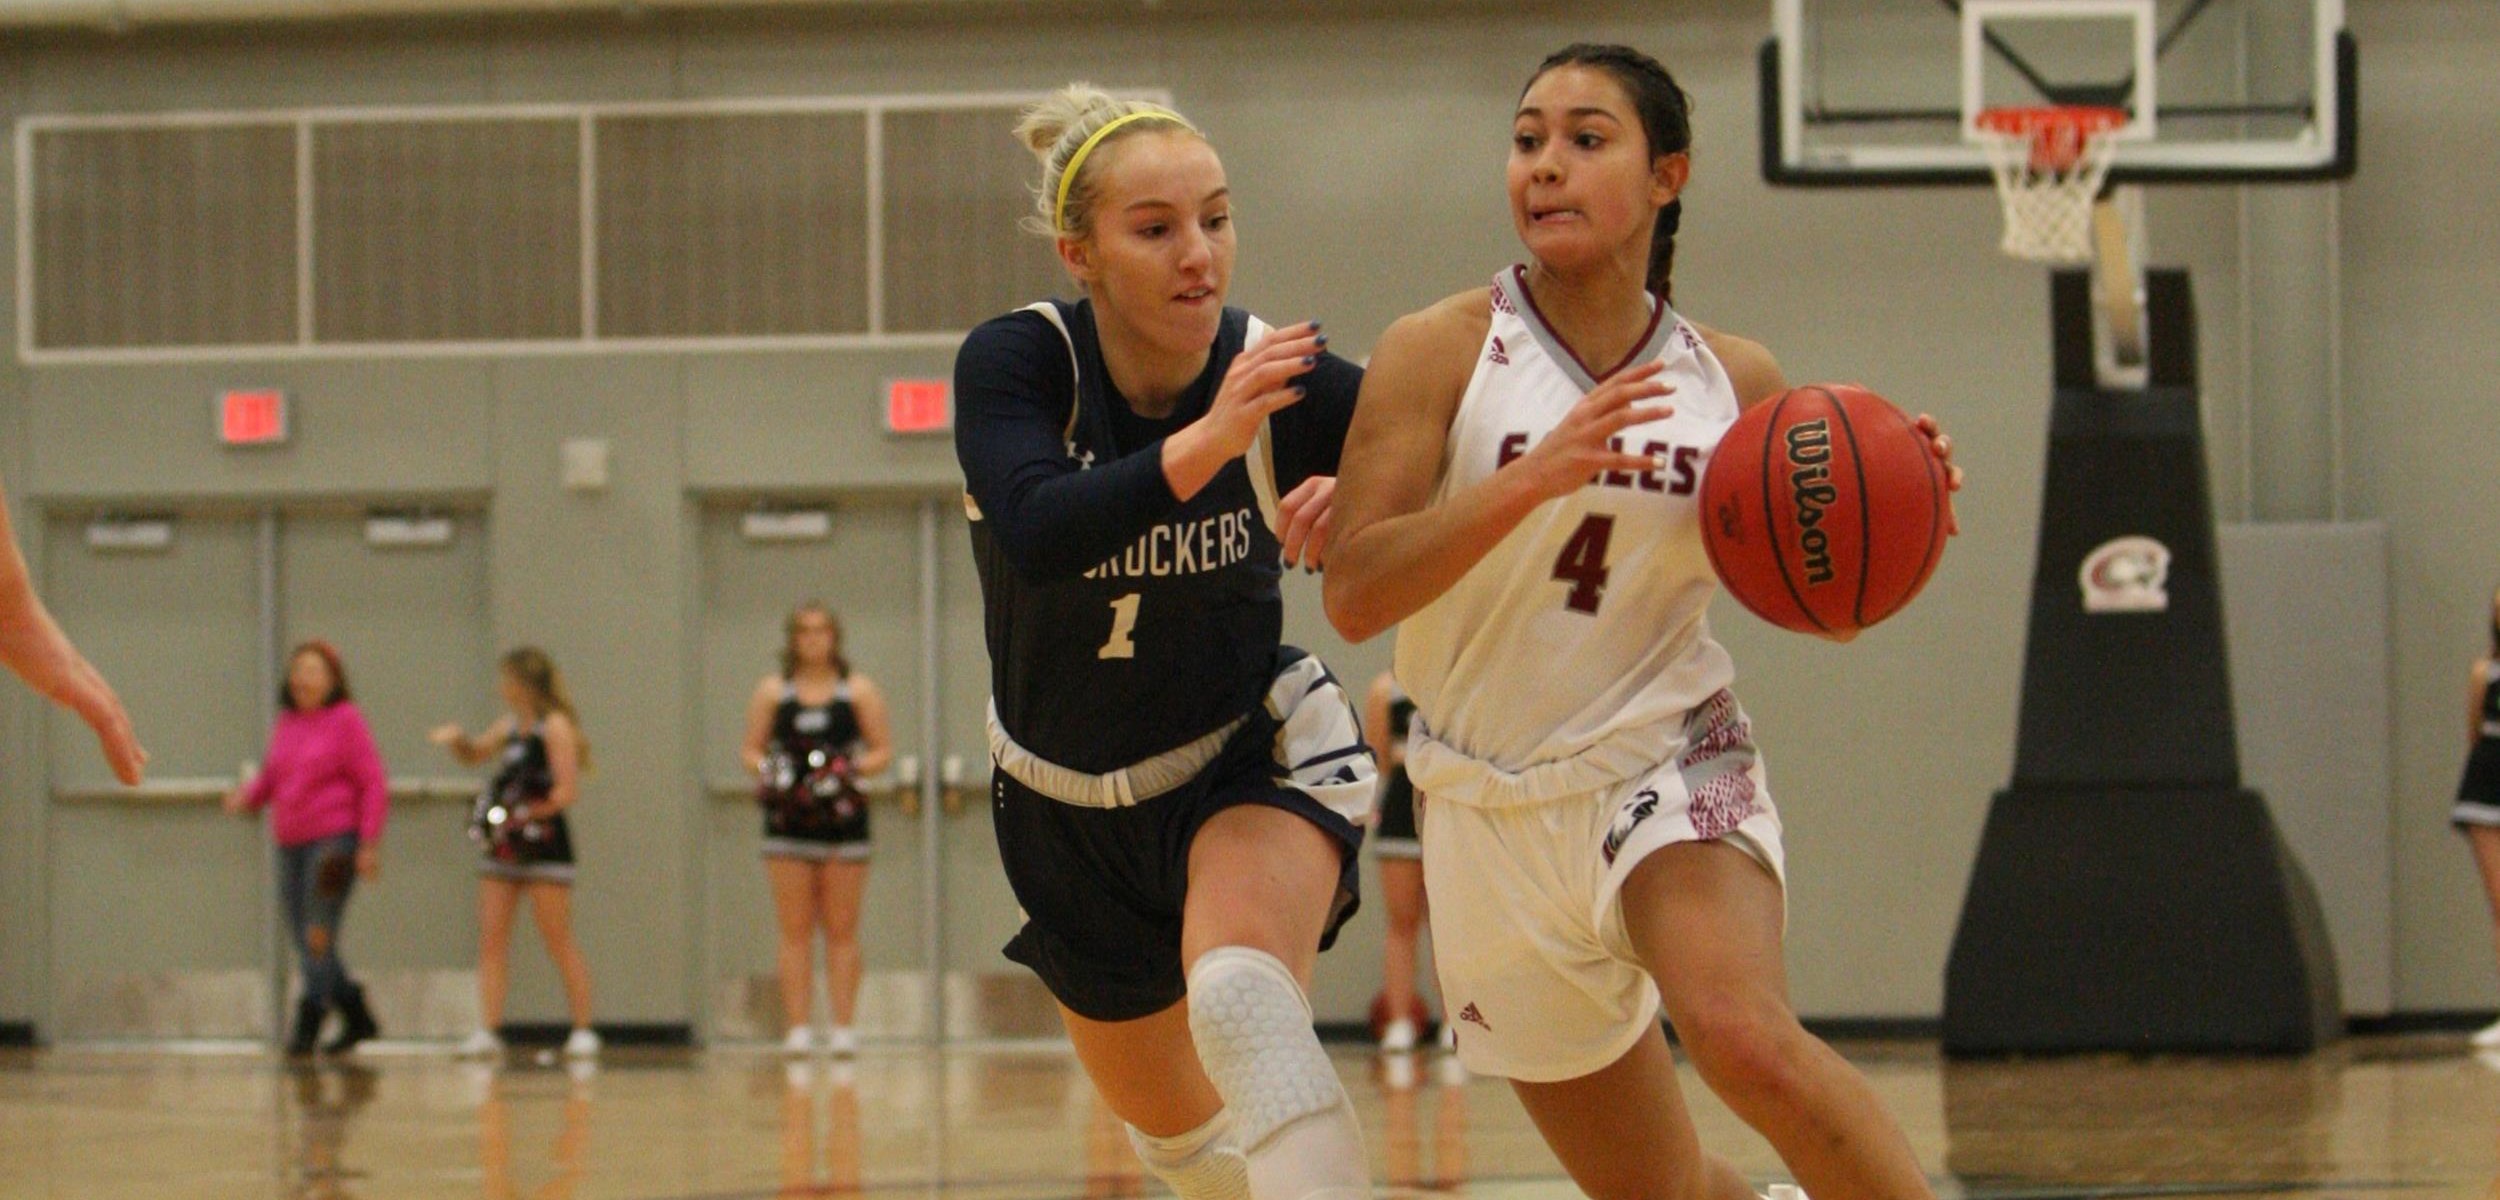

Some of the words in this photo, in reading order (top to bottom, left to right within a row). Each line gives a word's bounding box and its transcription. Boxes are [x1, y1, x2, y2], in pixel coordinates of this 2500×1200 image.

[1497, 430, 1699, 497] ELES
[1785, 416, 1837, 587] Wilson
[1550, 510, 1617, 618] 4
[1097, 592, 1142, 660] 1
